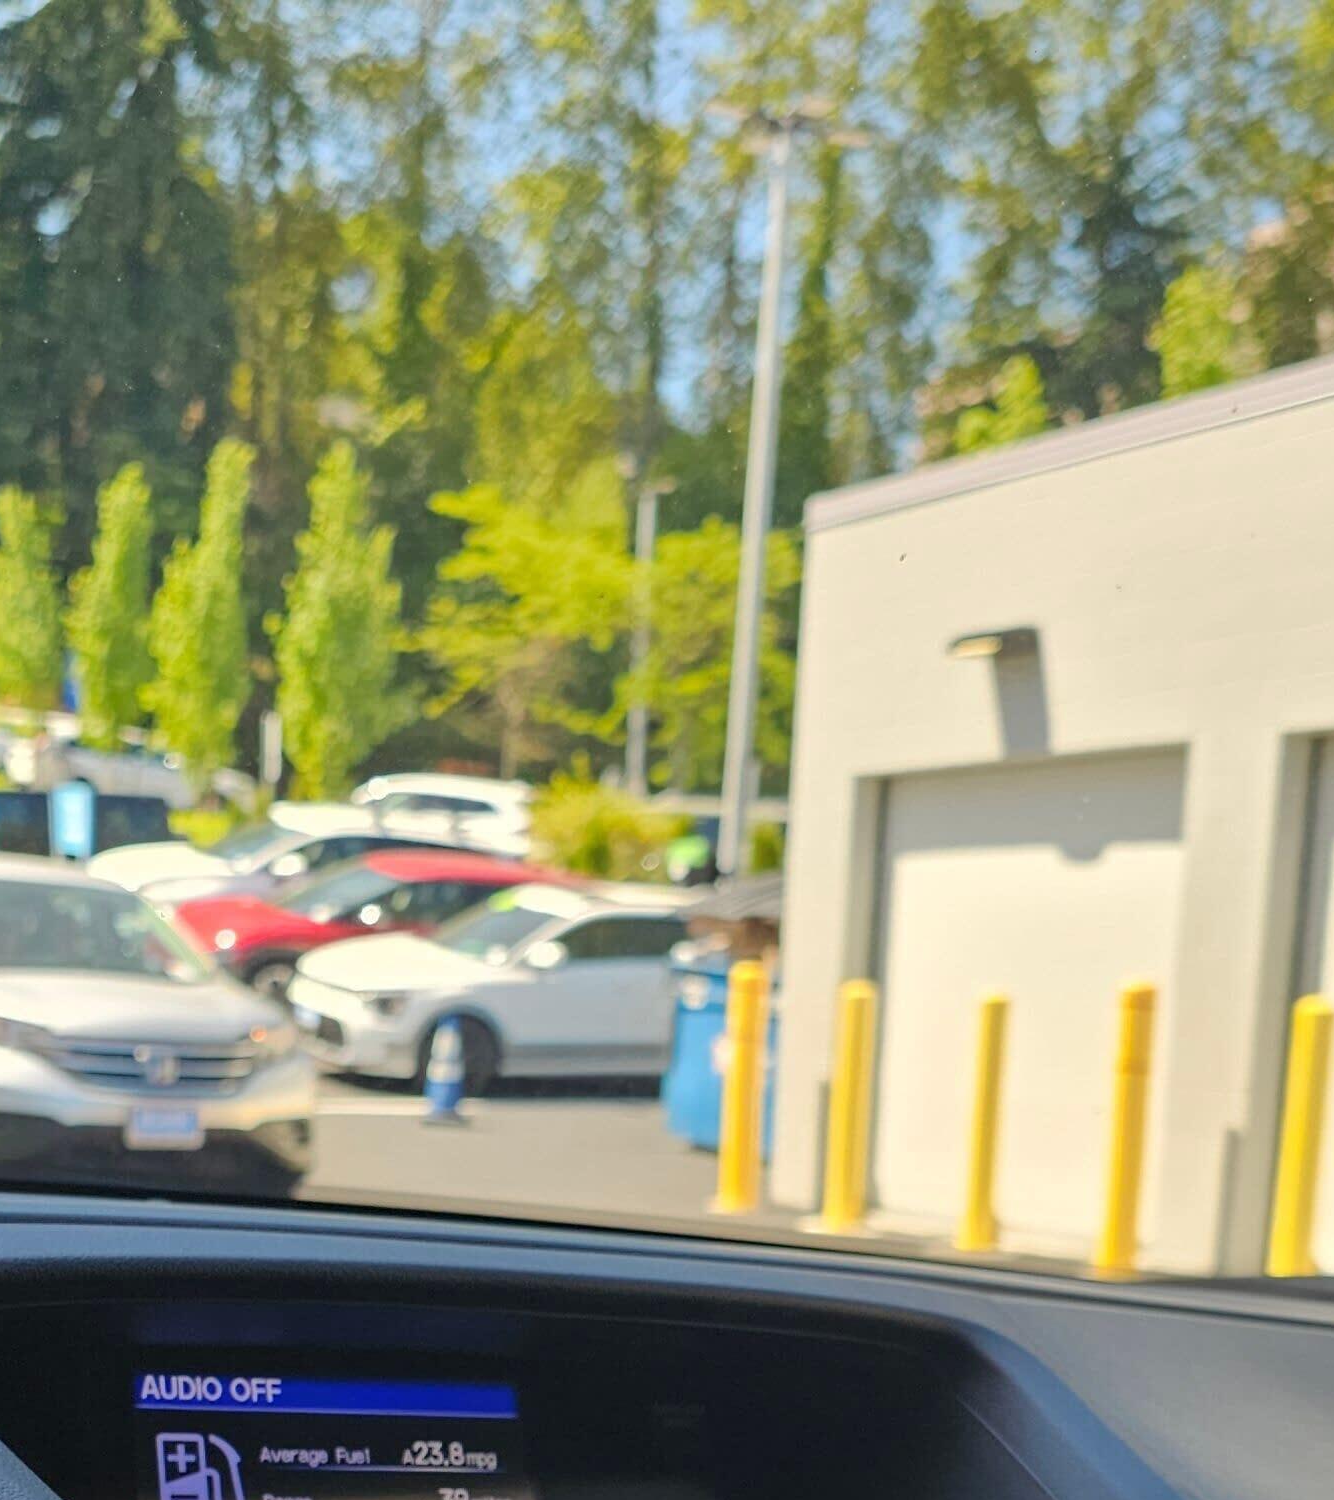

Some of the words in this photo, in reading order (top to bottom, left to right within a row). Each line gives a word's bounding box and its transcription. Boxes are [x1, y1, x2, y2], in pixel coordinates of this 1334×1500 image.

[141, 1374, 223, 1401] AUDIO
[229, 1377, 282, 1403] OFF
[260, 1447, 328, 1468] Average
[336, 1448, 371, 1465] Fuel
